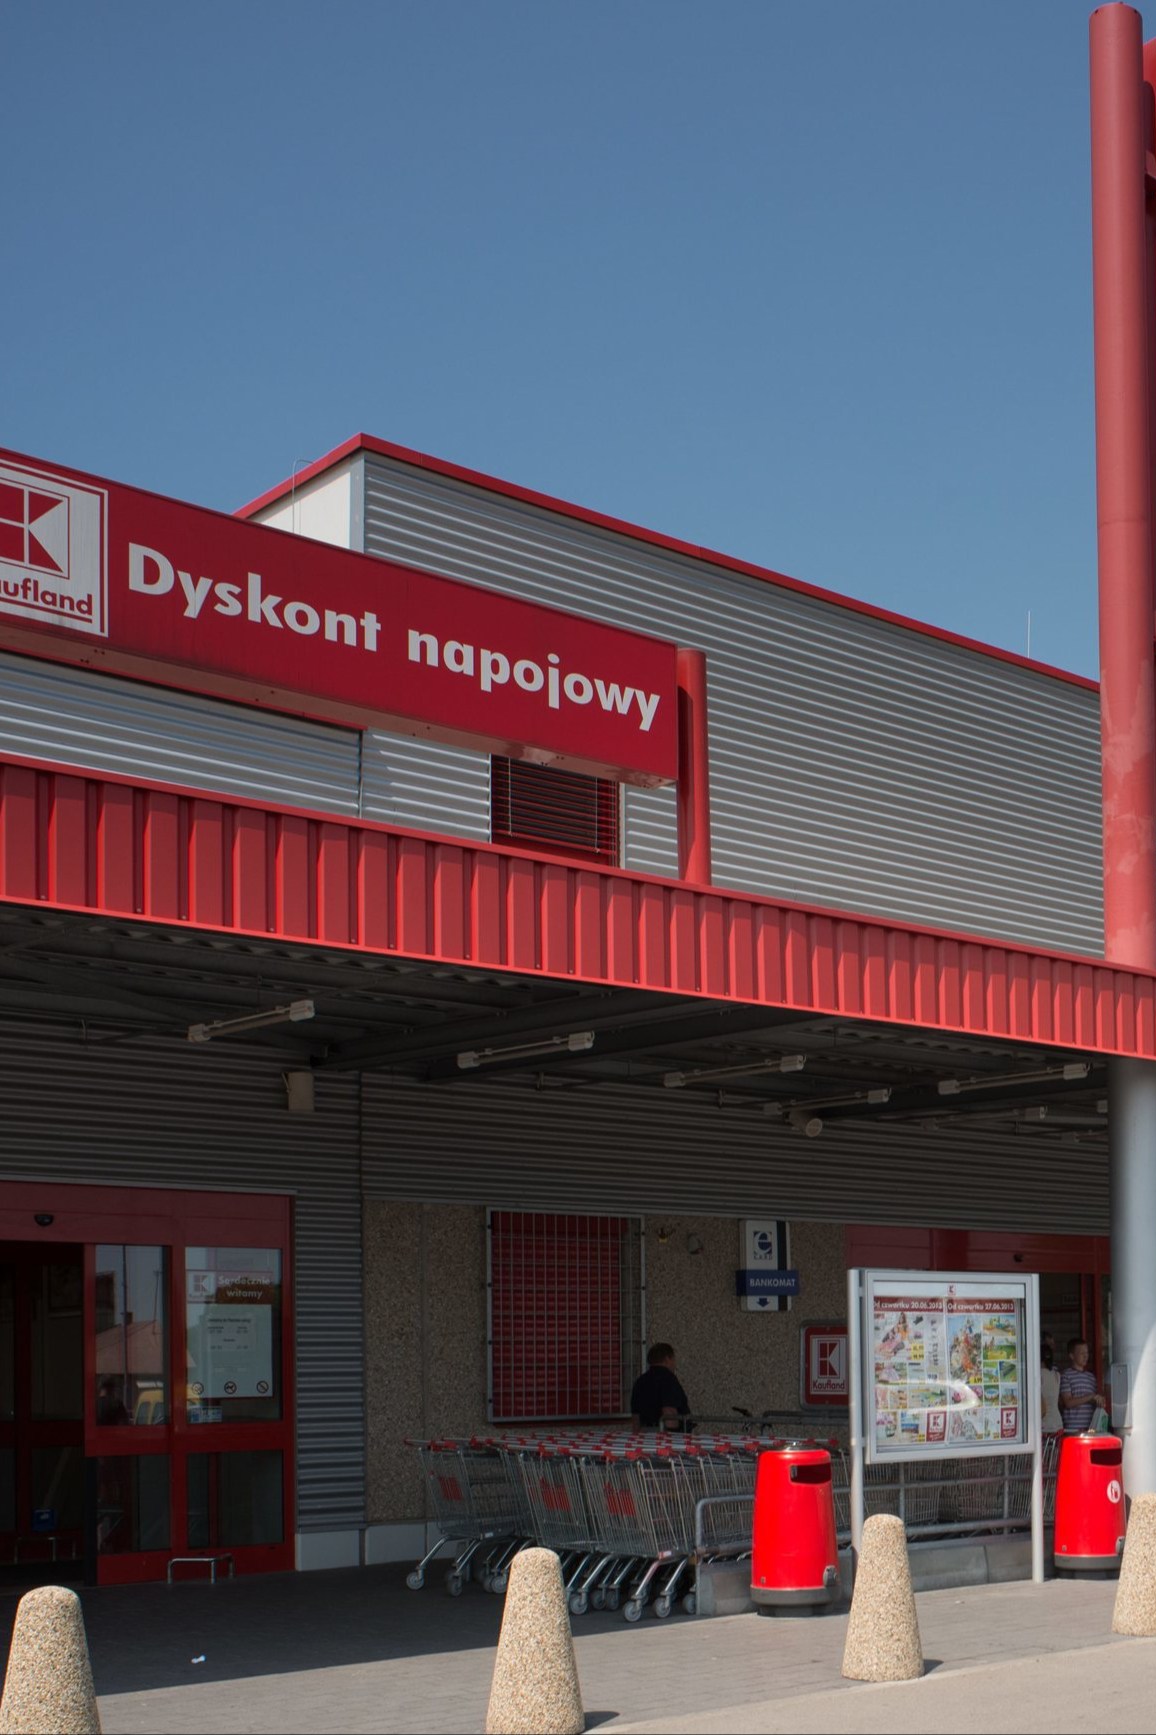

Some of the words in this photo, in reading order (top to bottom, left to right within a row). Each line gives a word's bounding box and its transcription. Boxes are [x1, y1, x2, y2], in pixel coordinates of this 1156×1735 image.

[0, 577, 93, 616] ufland
[128, 541, 382, 652] Dyskont
[407, 628, 661, 732] napojowy
[749, 1278, 796, 1287] BANKOMAT
[226, 1287, 263, 1299] witamy
[812, 1380, 845, 1389] Kaufland
